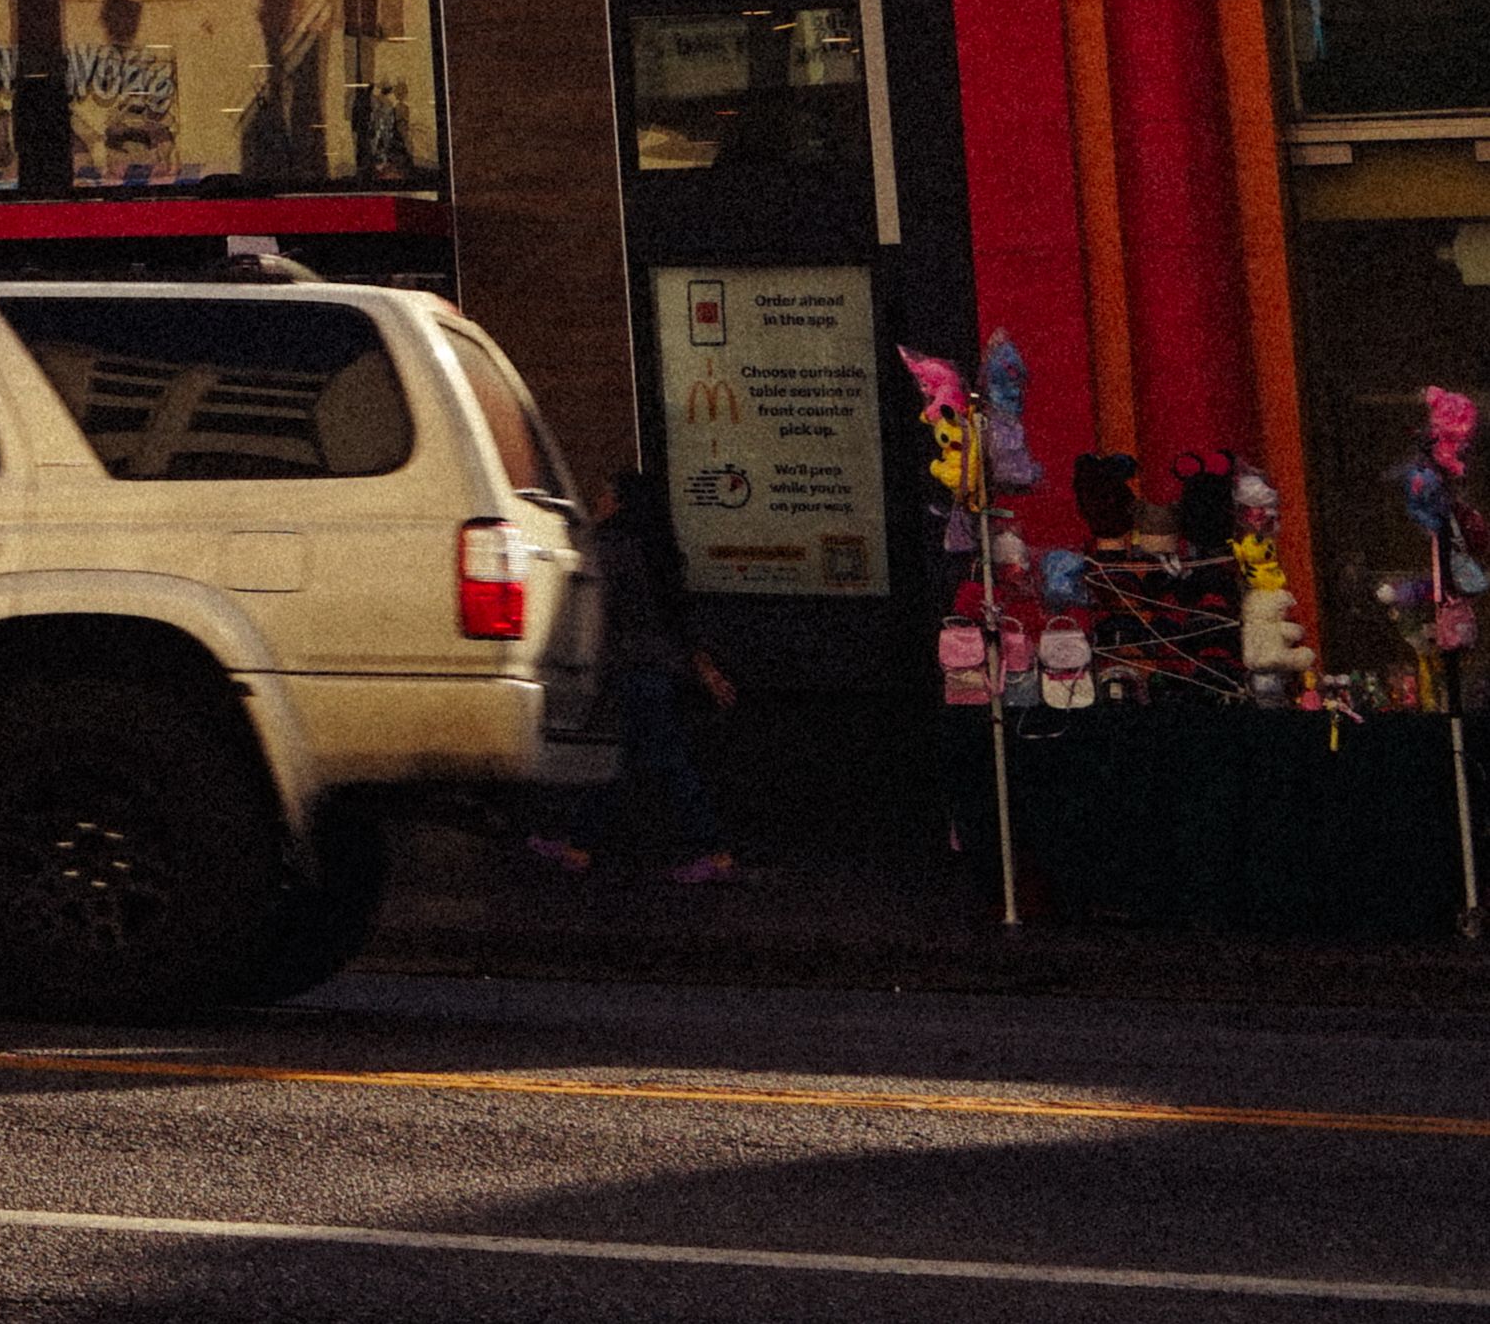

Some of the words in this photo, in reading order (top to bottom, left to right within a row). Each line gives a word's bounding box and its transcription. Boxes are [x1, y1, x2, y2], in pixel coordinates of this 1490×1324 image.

[754, 294, 796, 307] Order
[799, 294, 845, 307] ahead
[763, 314, 777, 325] in
[780, 314, 805, 325] the
[807, 316, 838, 328] app.
[740, 366, 796, 378] Choose
[749, 384, 786, 397] table
[789, 384, 843, 397] service
[846, 387, 861, 397] or
[758, 404, 794, 417] front
[797, 404, 854, 417] counter
[779, 424, 811, 438] pick
[768, 482, 808, 493] while
[769, 502, 788, 512] on
[791, 502, 821, 515] your
